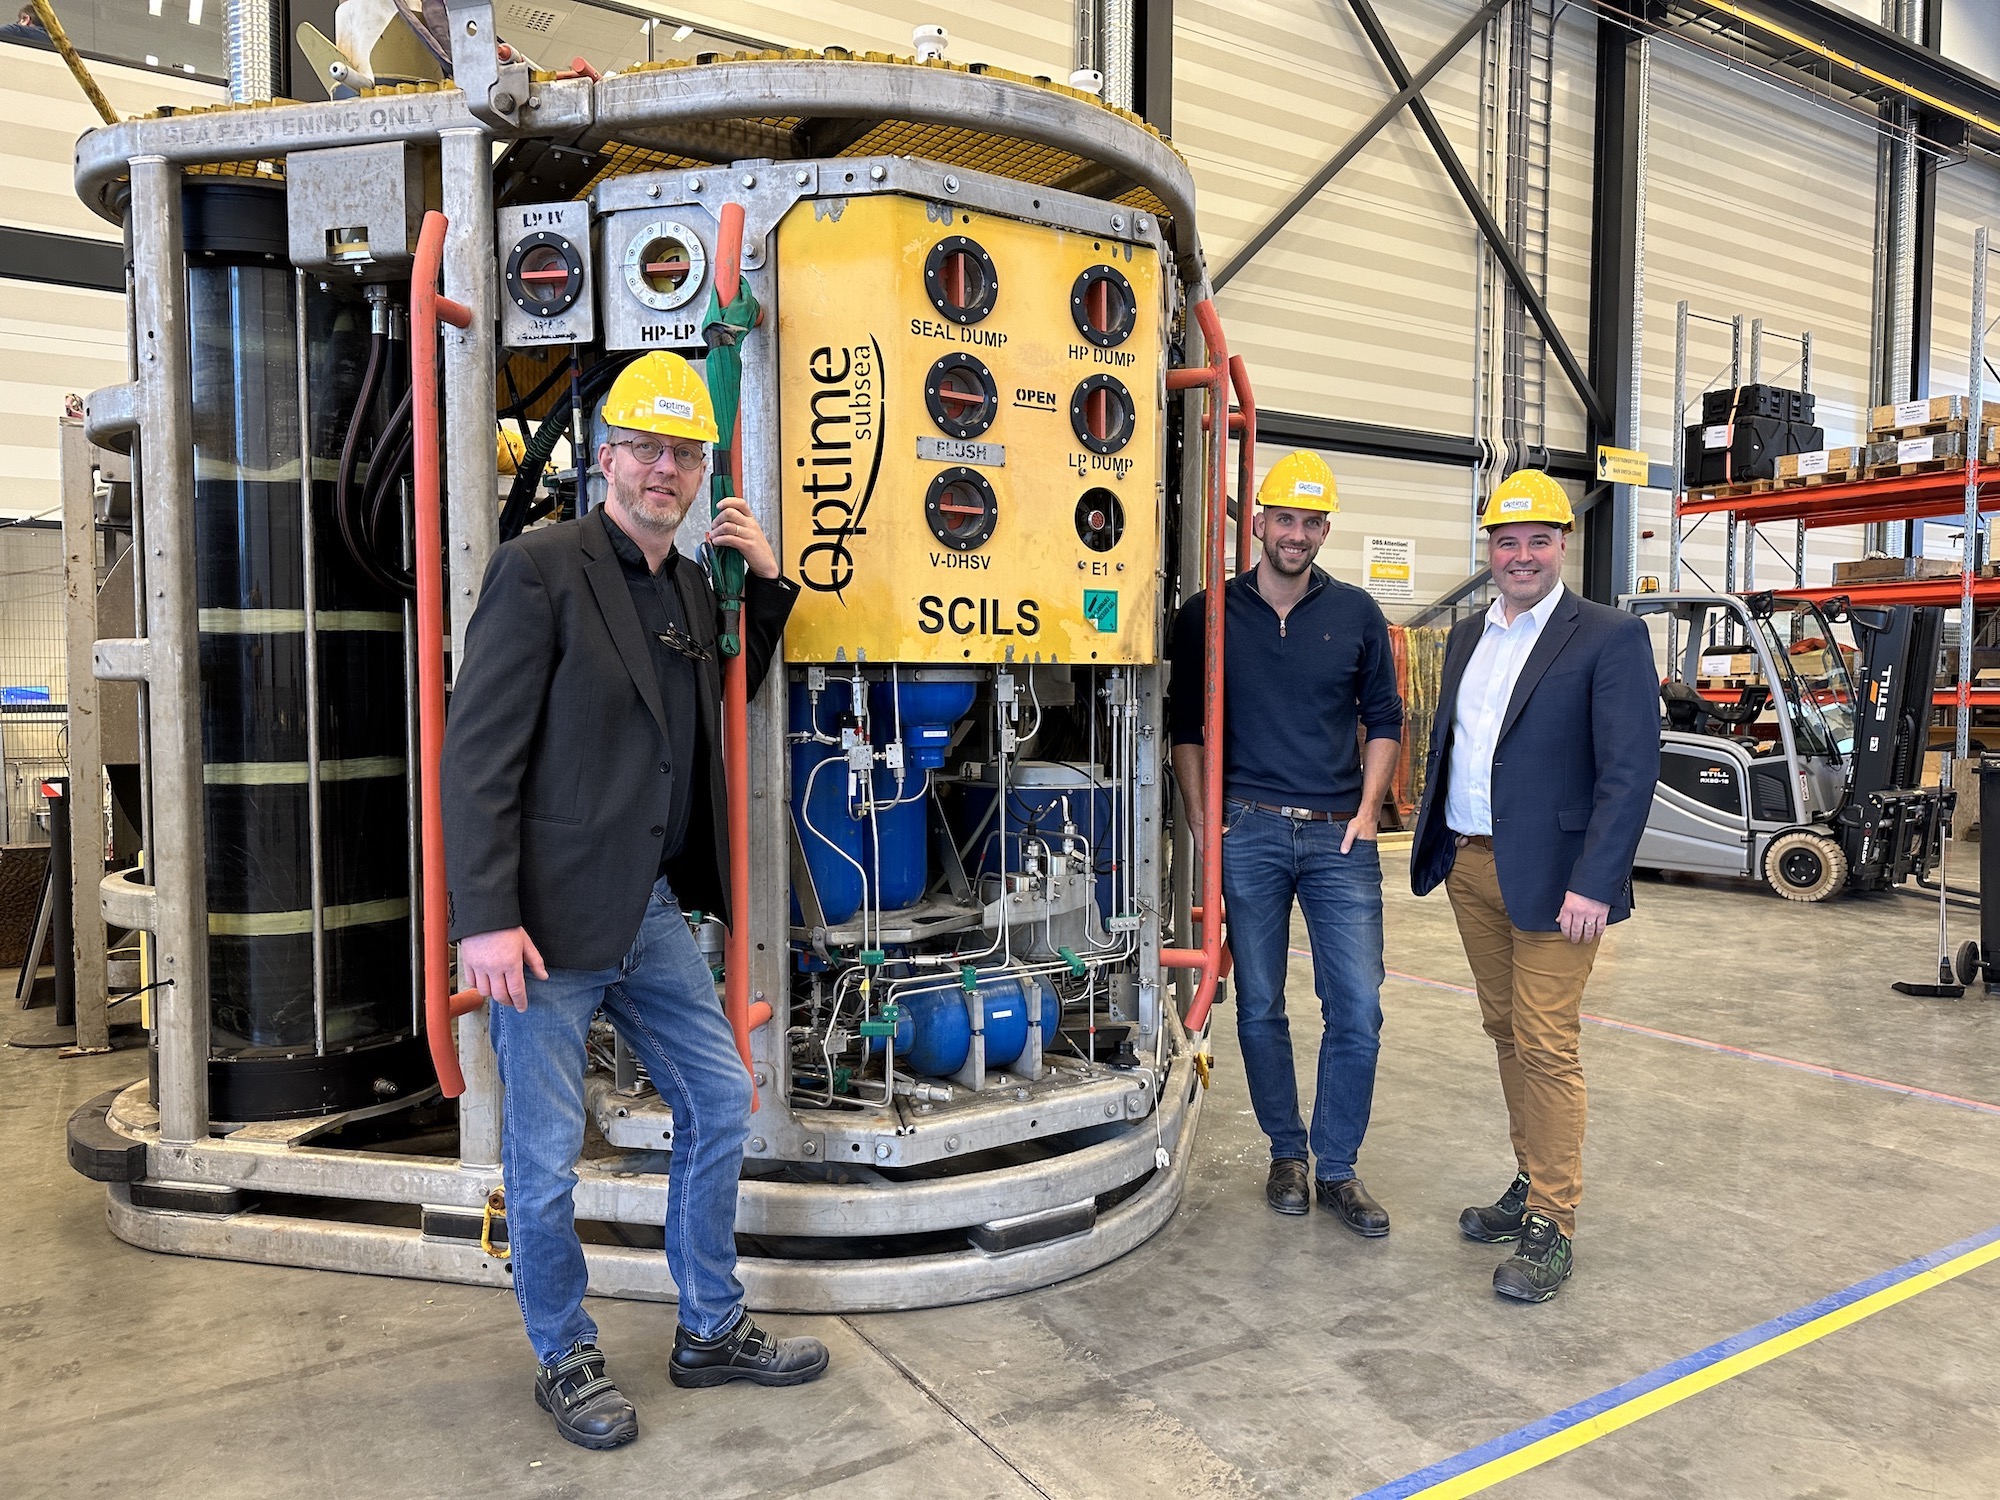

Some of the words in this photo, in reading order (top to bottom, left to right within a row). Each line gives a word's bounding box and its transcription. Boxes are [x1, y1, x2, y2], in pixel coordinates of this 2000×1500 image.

[165, 126, 211, 145] SEA
[219, 112, 360, 143] FASTENING
[369, 104, 438, 129] ONLY
[641, 324, 696, 342] HP-LP
[911, 319, 955, 341] SEAL
[961, 327, 1008, 349] DUMP
[1068, 344, 1089, 360] HP
[1093, 348, 1136, 367] DUMP
[848, 345, 871, 440] subsea
[1016, 388, 1057, 405] OPEN
[659, 399, 691, 413] Optime
[936, 441, 987, 461] FLUSH
[797, 346, 867, 593] Optime
[1068, 453, 1087, 468] LP
[1092, 456, 1134, 473] DUMP
[929, 552, 991, 570] V-DHSV
[1092, 562, 1108, 576] E1
[918, 595, 1041, 637] SCILS
[1875, 664, 1893, 722] STILL
